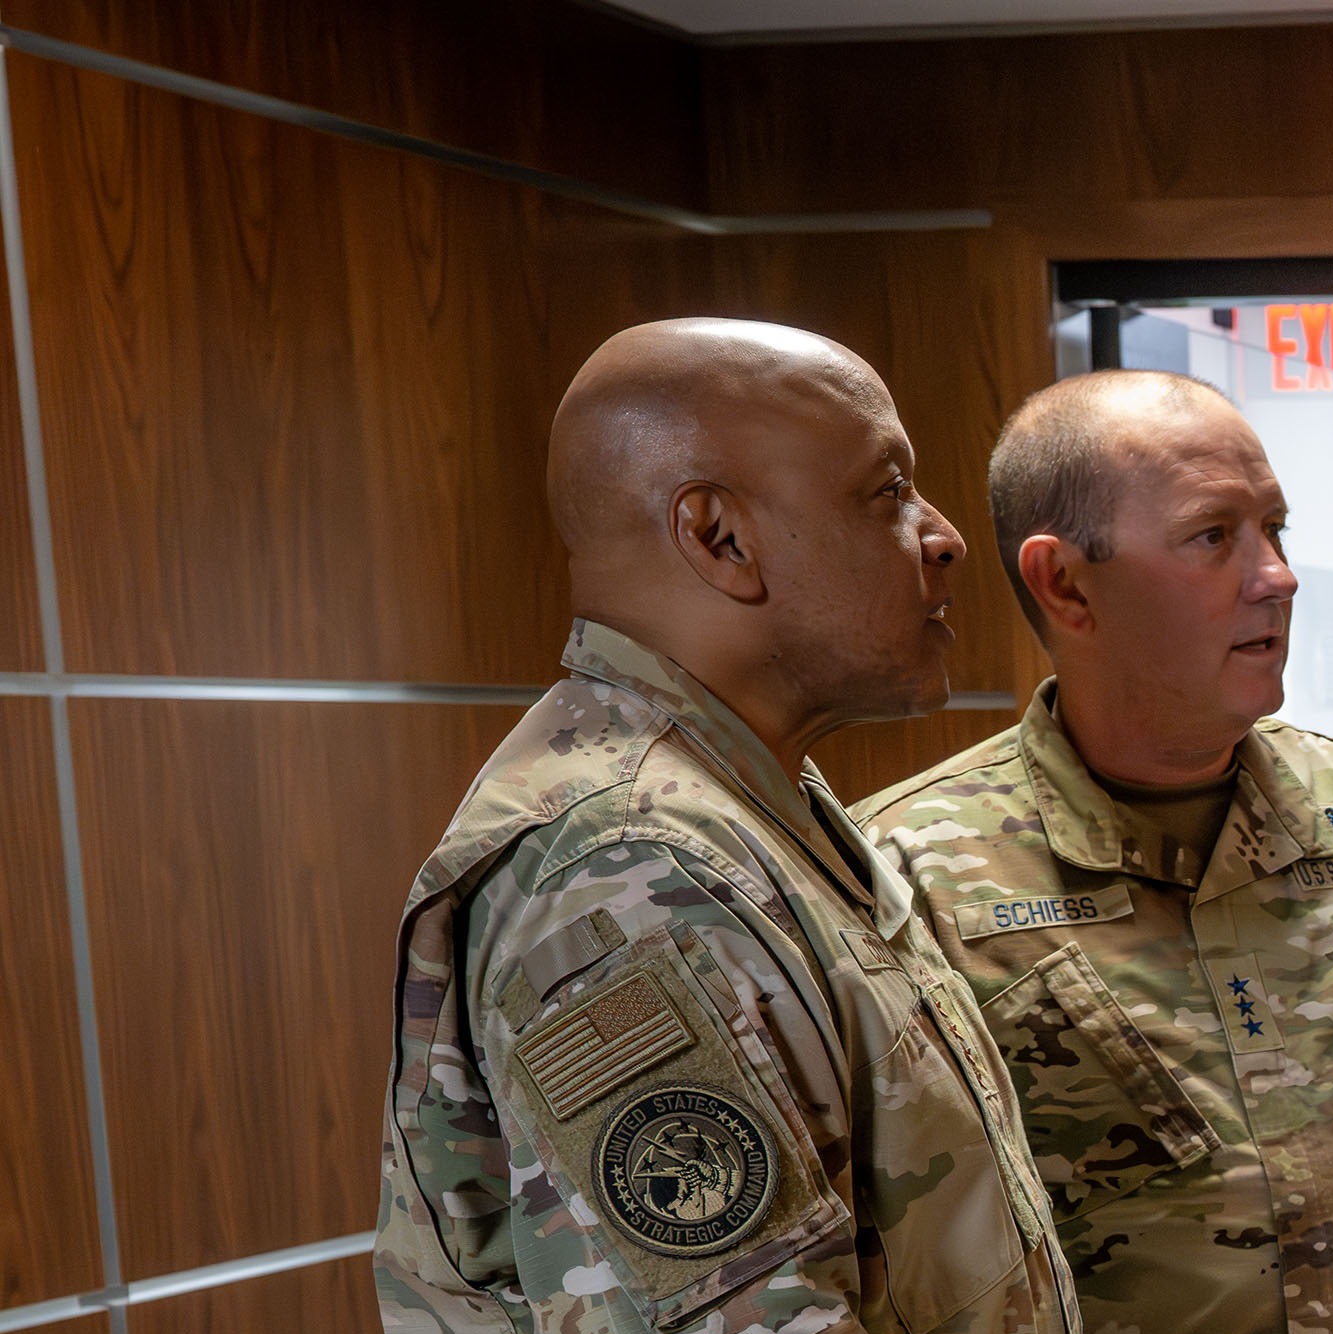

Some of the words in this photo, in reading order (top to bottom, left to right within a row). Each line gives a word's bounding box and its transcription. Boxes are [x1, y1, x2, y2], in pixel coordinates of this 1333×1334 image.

[993, 896, 1099, 928] SCHIESS
[606, 1107, 648, 1164] UNITED
[652, 1093, 719, 1116] STATES
[629, 1211, 725, 1244] STRATEGIC
[725, 1150, 767, 1228] COMMAND
